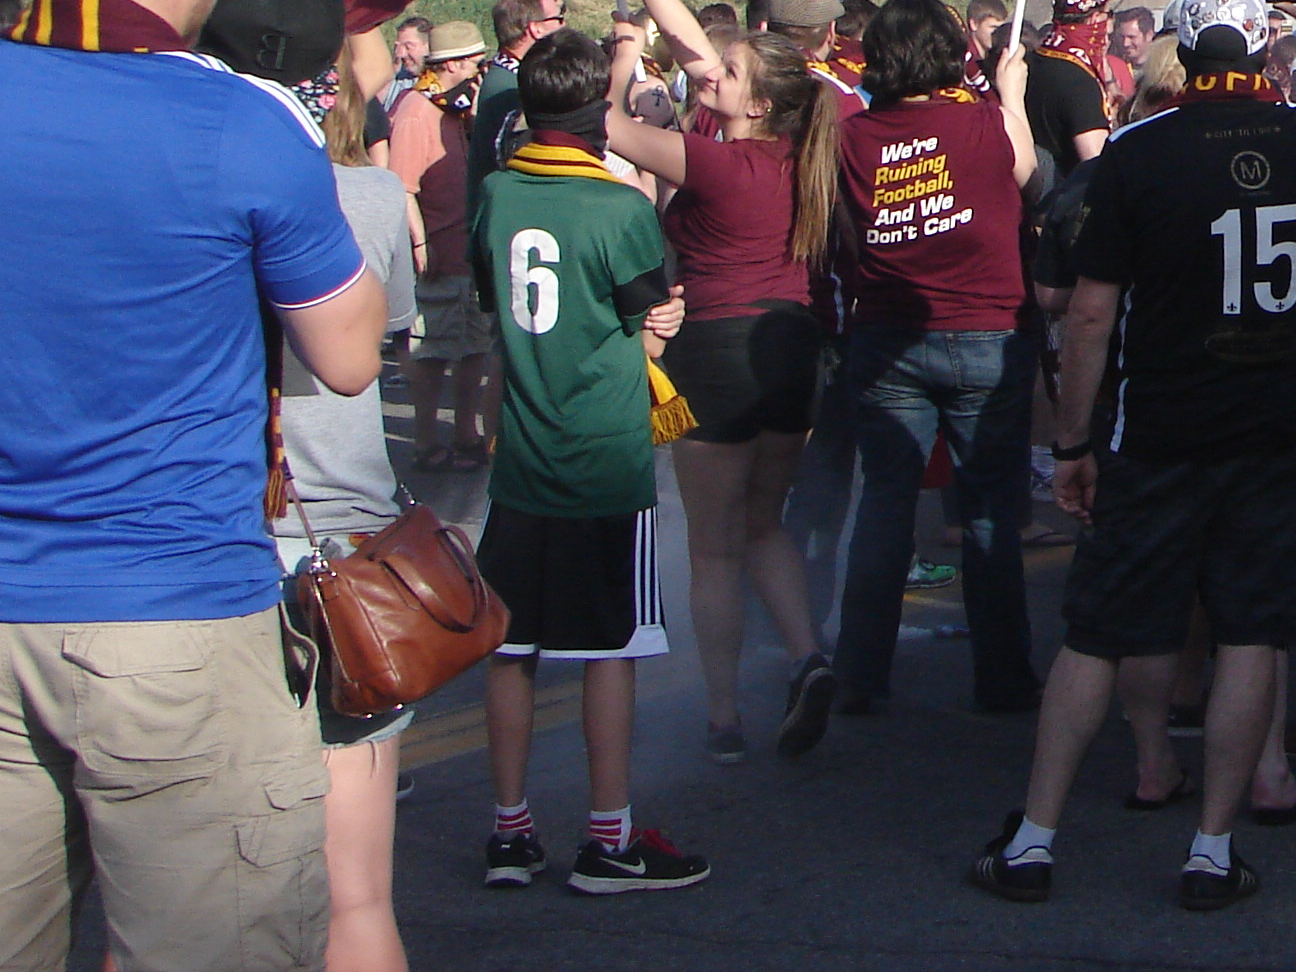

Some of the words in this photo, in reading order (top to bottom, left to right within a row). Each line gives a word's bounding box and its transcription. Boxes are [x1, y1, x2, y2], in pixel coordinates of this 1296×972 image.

[881, 136, 938, 164] We're
[875, 154, 947, 186] Ruining
[872, 170, 954, 208] Football,
[866, 225, 918, 244] Don't
[923, 207, 974, 236] Care
[874, 202, 915, 227] And
[920, 193, 955, 217] We
[511, 228, 561, 335] 6
